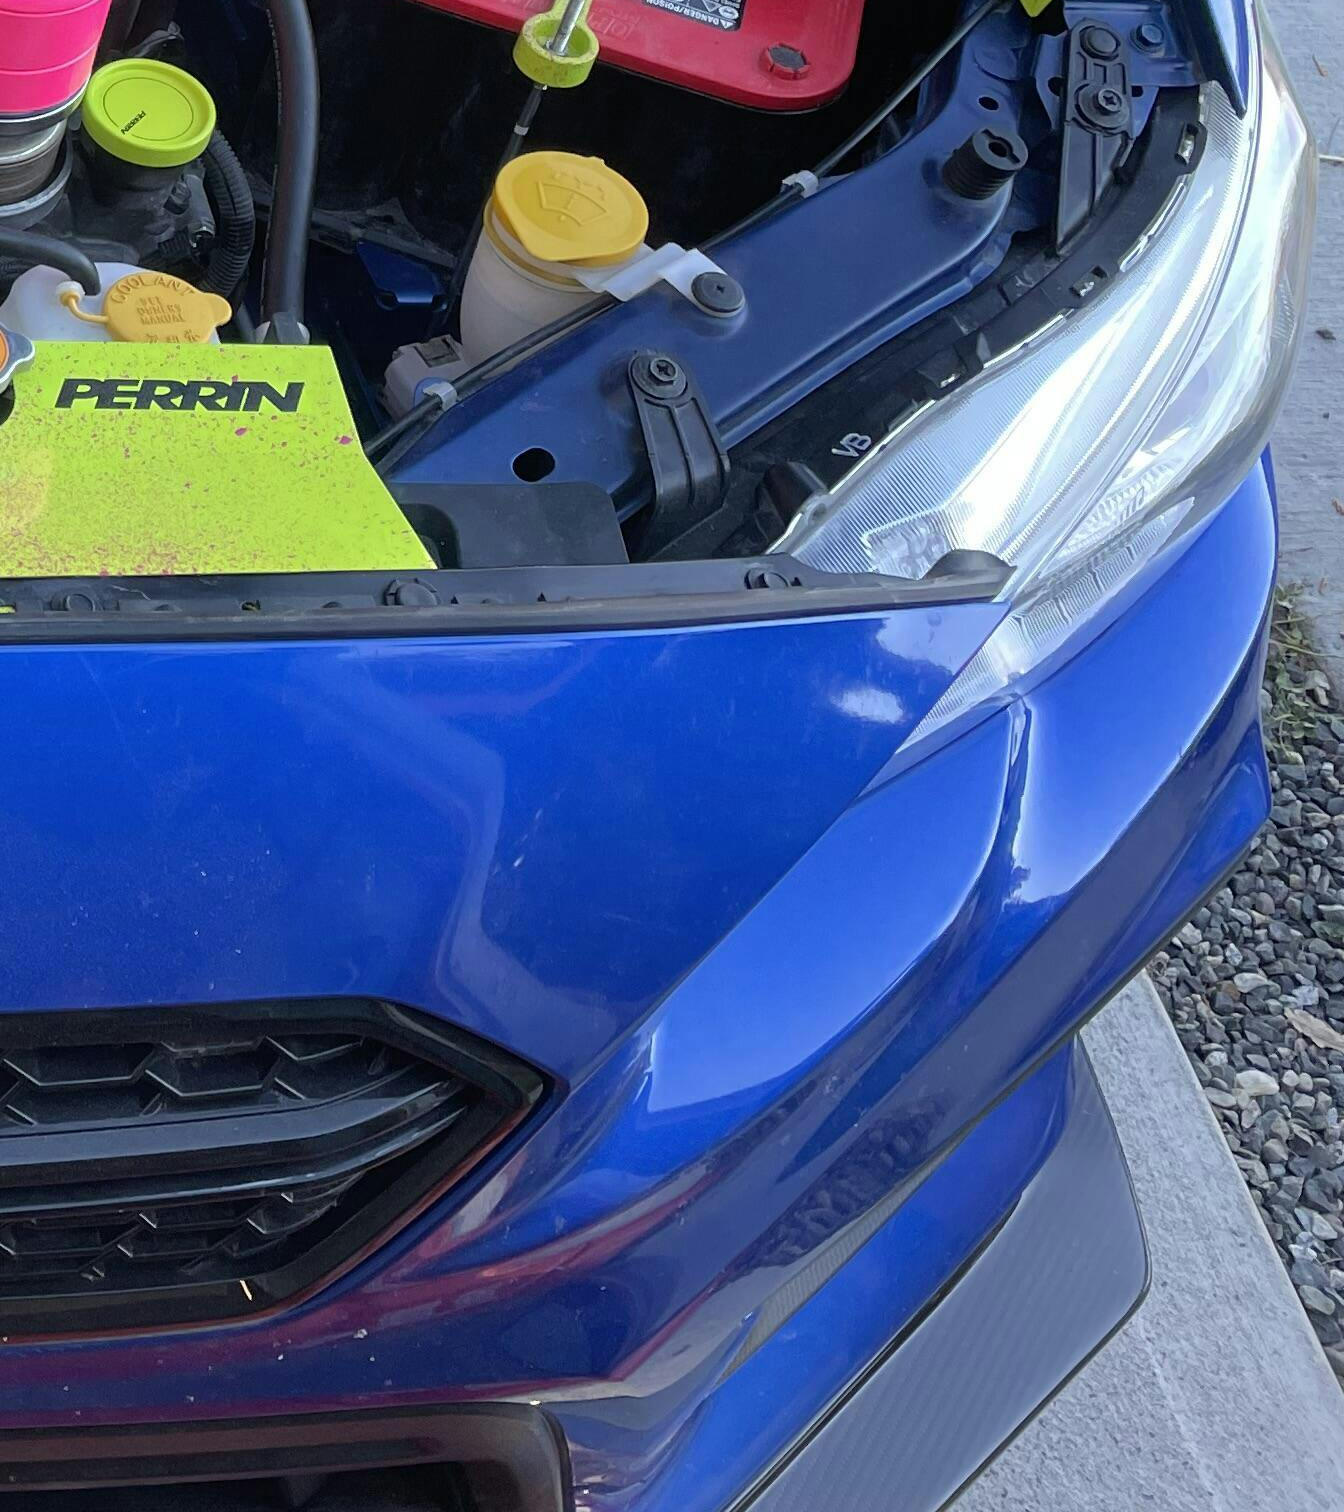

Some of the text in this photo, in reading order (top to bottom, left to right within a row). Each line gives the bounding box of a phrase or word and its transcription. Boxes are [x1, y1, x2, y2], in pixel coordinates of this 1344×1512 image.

[120, 109, 147, 136] PERRIN
[111, 275, 196, 304] COOLANT
[54, 378, 305, 413] PERRIN
[832, 433, 872, 458] VB
